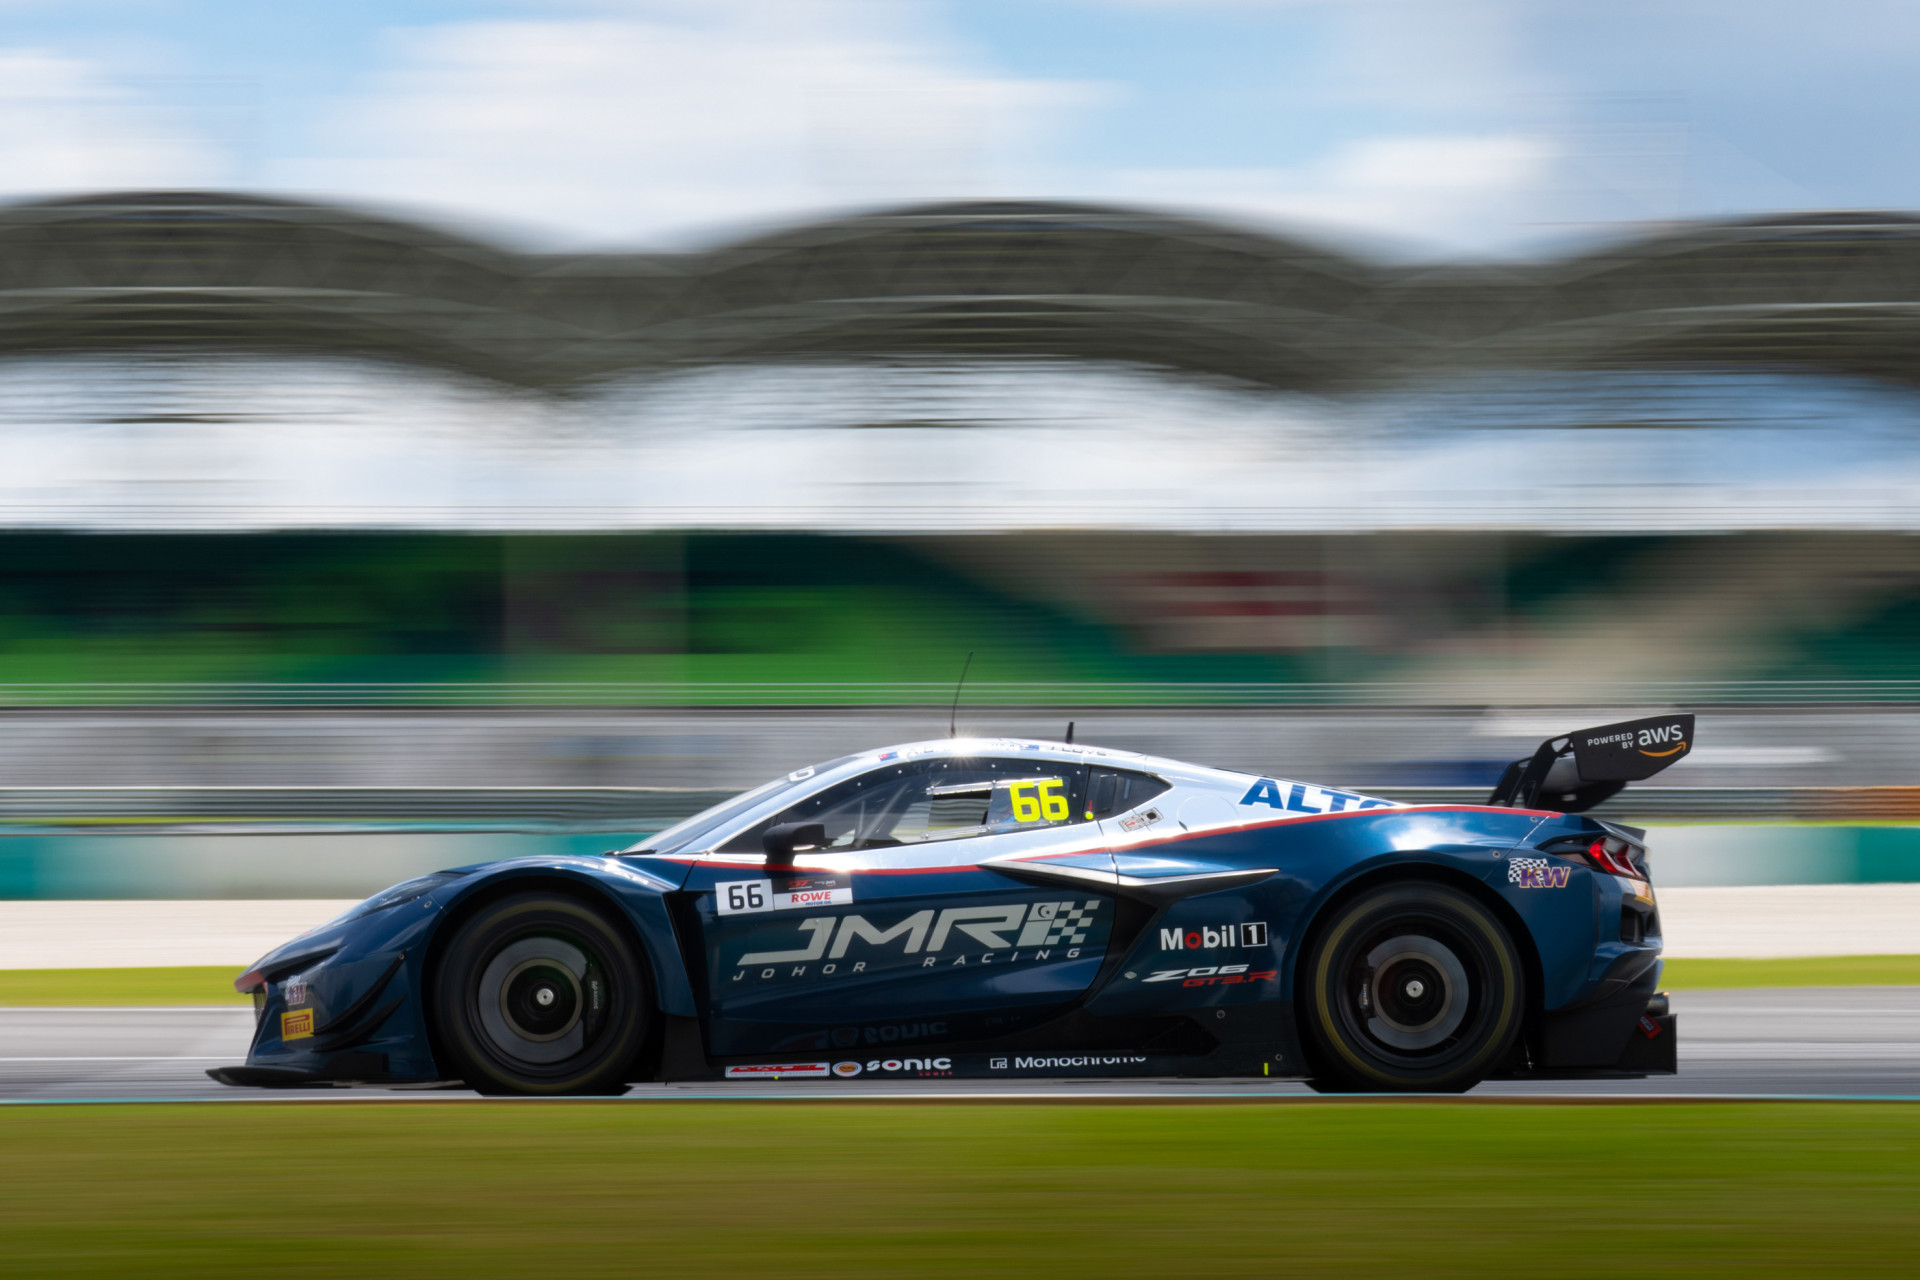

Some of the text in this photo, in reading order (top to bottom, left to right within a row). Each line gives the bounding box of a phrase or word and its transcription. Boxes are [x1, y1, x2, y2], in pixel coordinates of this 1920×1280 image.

[1587, 732, 1634, 747] POWERED
[1622, 740, 1634, 749] BY
[1638, 724, 1683, 746] aws
[1009, 779, 1069, 823] 66
[1519, 866, 1571, 889] KW
[728, 883, 763, 910] 66
[791, 891, 832, 903] ROWE
[736, 904, 1028, 966] JMR
[1160, 924, 1236, 951] Mobil
[732, 947, 1081, 982] JOHOR RACING
[1141, 963, 1250, 983] Z06
[284, 1013, 310, 1036] PIRELLI
